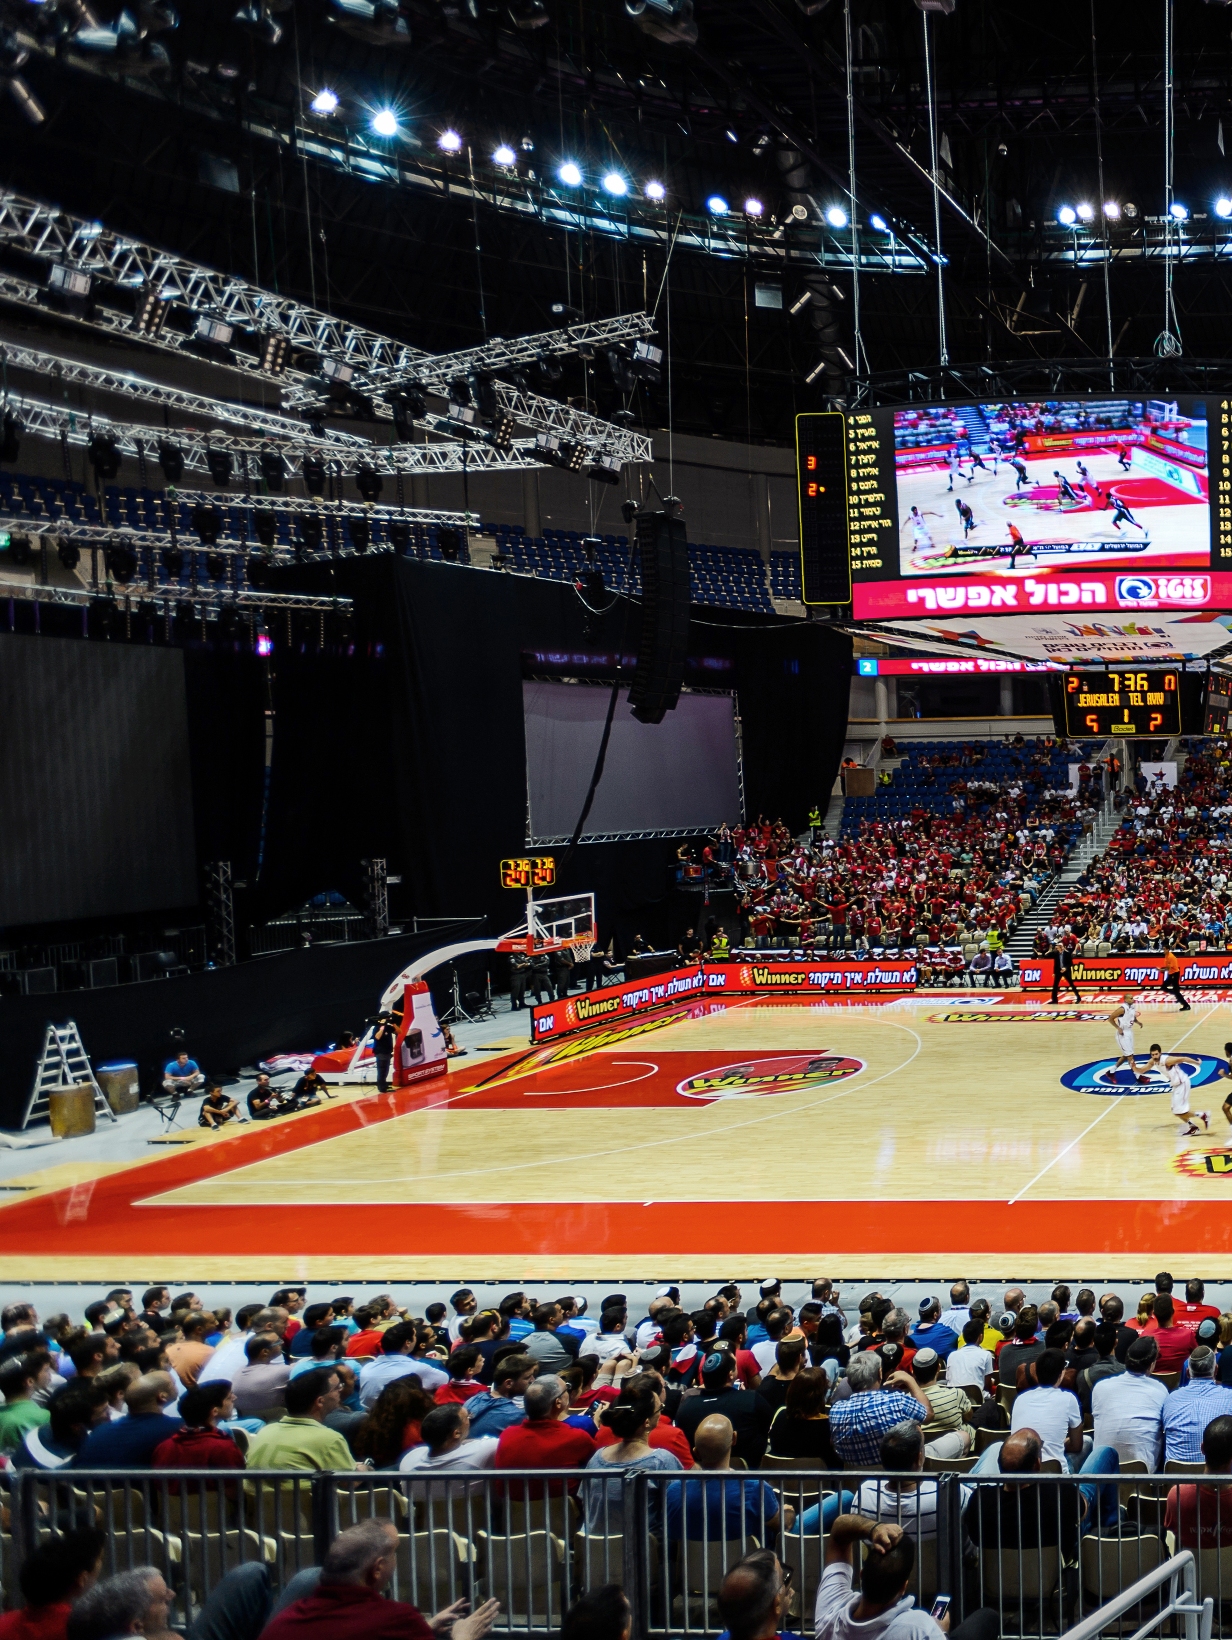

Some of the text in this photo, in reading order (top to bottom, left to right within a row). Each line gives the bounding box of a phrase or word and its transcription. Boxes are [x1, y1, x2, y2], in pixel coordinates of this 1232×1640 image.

[1221, 400, 1228, 410] 4
[848, 416, 854, 425] 4
[1222, 414, 1229, 423] 5
[849, 429, 855, 438] 5
[1222, 427, 1229, 437] 6
[849, 443, 856, 452] 6
[1222, 441, 1229, 450] 7
[807, 457, 816, 469] 3
[850, 456, 856, 465] 7
[1222, 454, 1229, 464] 8
[850, 469, 857, 478] 8
[1222, 468, 1230, 477] 9
[808, 484, 817, 496] 2
[851, 482, 858, 491] 9
[1219, 481, 1231, 490] 10
[849, 495, 859, 504] 10
[1219, 495, 1230, 504] 11
[849, 509, 859, 517] 11
[1219, 508, 1231, 517] 12
[850, 522, 860, 530] 12
[1220, 521, 1232, 531] 13
[851, 535, 860, 543] 13
[1220, 535, 1232, 544] 14
[851, 548, 861, 556] 14
[1220, 548, 1232, 557] 15
[851, 561, 861, 569] 15
[906, 578, 1107, 610] הכול אפשרי
[863, 662, 871, 672] 2
[911, 661, 974, 672] אפשרי
[1068, 677, 1079, 692] 2
[1108, 673, 1149, 691] 7:36
[1165, 675, 1176, 690] 0
[1128, 692, 1144, 706] TEL
[752, 965, 806, 986] Winner
[902, 968, 917, 983] לא
[1024, 969, 1041, 982] אם
[1071, 963, 1121, 981] Winner
[1125, 967, 1159, 984] תיקח?
[708, 973, 726, 987] אם
[809, 972, 841, 989] תיקח?
[844, 971, 862, 990] איך
[1058, 994, 1123, 1003] PAIS
[576, 997, 620, 1020] Winner
[945, 1013, 1076, 1022] Winner
[539, 1014, 554, 1033] אם
[691, 1069, 856, 1088] Winner
